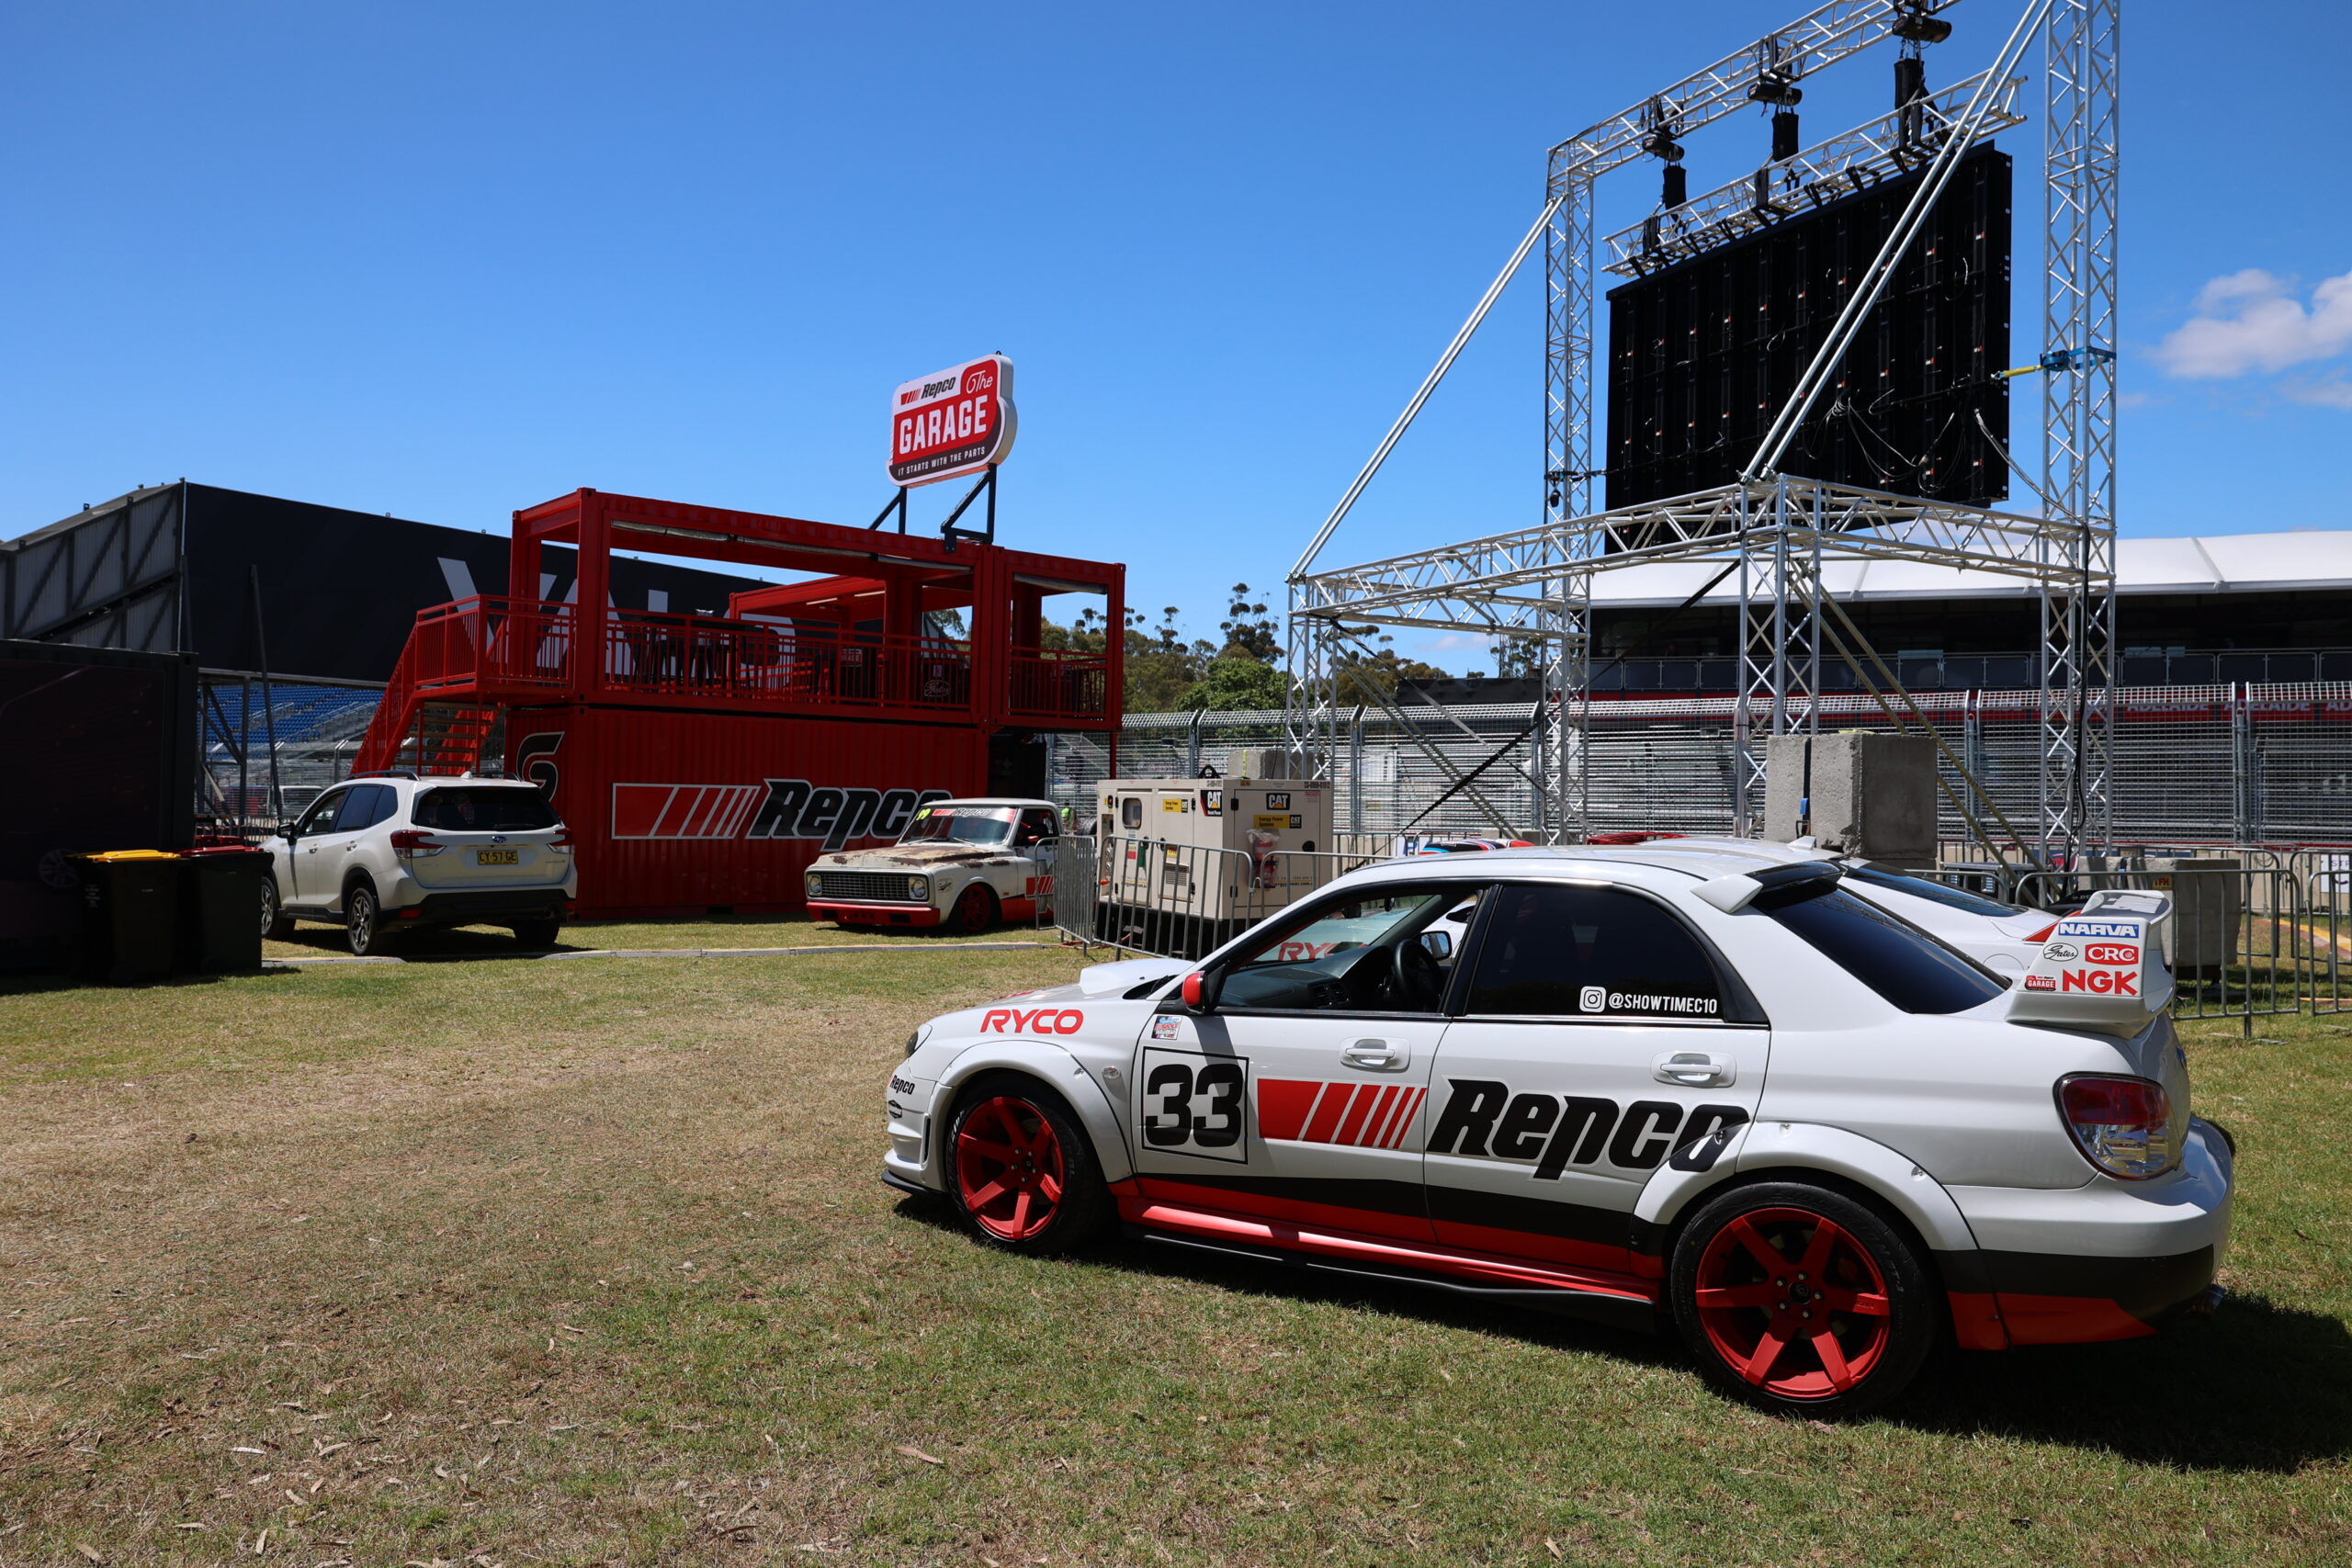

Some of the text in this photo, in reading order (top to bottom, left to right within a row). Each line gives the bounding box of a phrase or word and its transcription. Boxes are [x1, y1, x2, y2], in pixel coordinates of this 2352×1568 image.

[921, 377, 956, 399] Repco
[966, 370, 993, 394] The
[899, 394, 989, 455] GARAGE
[898, 446, 986, 477] IT STARTS WITH THE PARTS
[1207, 791, 1222, 808] CAT
[1269, 794, 1288, 808] CAT
[1290, 816, 1301, 824] CAT
[2060, 923, 2136, 937] NARVA
[2047, 944, 2075, 959] Gates
[2087, 946, 2136, 962] CRC
[2062, 969, 2138, 996] NGK
[1608, 992, 1718, 1014] @SHOWTIMEC10
[979, 1009, 1084, 1034] RYCO
[889, 1075, 915, 1095] Repco
[1145, 1063, 1243, 1147] 33
[1425, 1078, 1750, 1181] Repco
